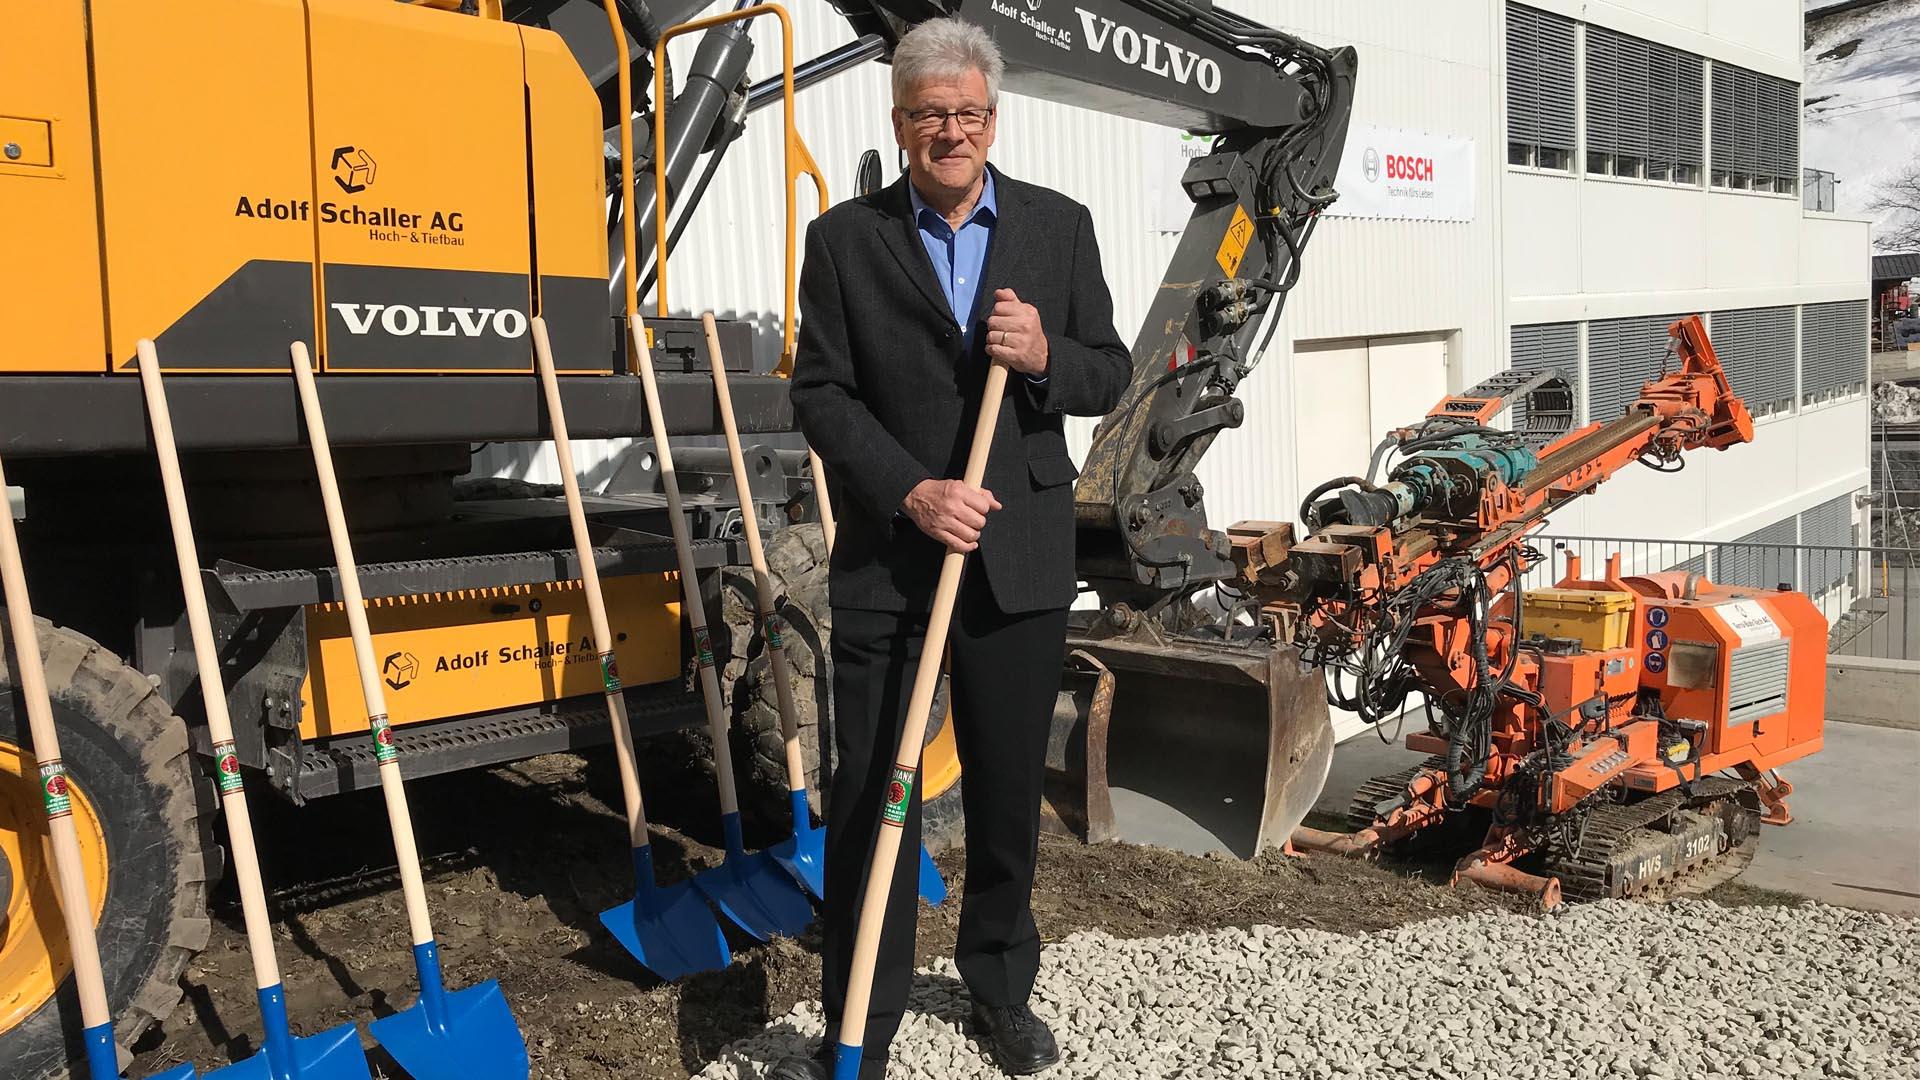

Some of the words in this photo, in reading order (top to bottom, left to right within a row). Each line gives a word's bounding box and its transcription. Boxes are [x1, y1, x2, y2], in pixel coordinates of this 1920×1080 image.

[991, 0, 1018, 19] Adolf
[1020, 11, 1056, 36] Schaller
[1058, 28, 1071, 43] AG
[1074, 7, 1222, 94] VOLVO
[1386, 154, 1433, 181] BOSCH
[235, 196, 309, 221] Adolf
[320, 202, 422, 229] Schaller
[430, 211, 464, 232] AG
[369, 229, 407, 242] Hoch-
[410, 231, 419, 243] &
[421, 232, 464, 246] Tiefbau
[331, 303, 527, 339] VOLVO
[435, 650, 488, 672] Adolf
[499, 641, 573, 664] Schaller
[579, 636, 597, 652] A
[534, 658, 563, 670] Hoch-
[564, 655, 571, 665] &
[573, 652, 599, 664] Tiefba
[1639, 855, 1661, 879] HVS
[1685, 834, 1710, 858] 3102
